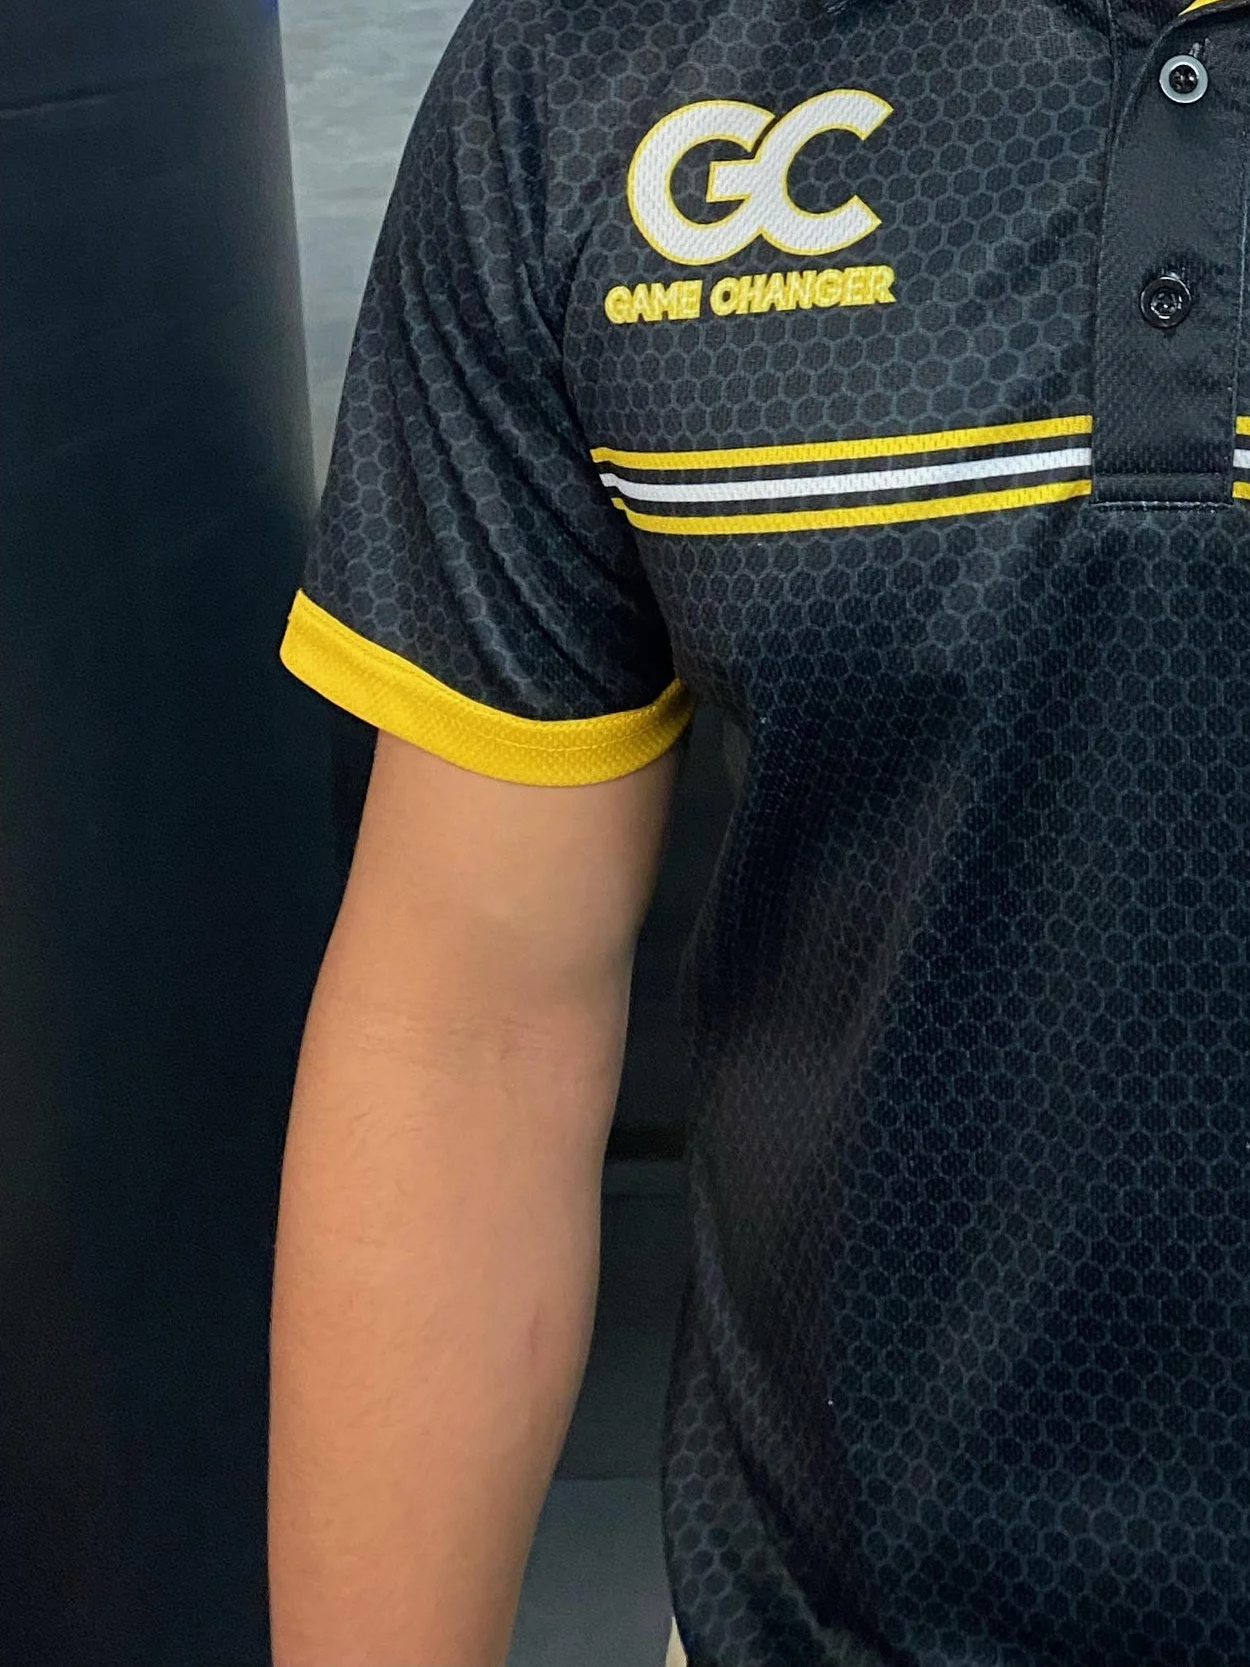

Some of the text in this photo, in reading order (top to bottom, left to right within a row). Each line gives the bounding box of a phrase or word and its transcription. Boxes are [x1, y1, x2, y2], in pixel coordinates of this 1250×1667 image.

[627, 88, 894, 266] GC
[604, 264, 897, 324] GAME CHANGER
